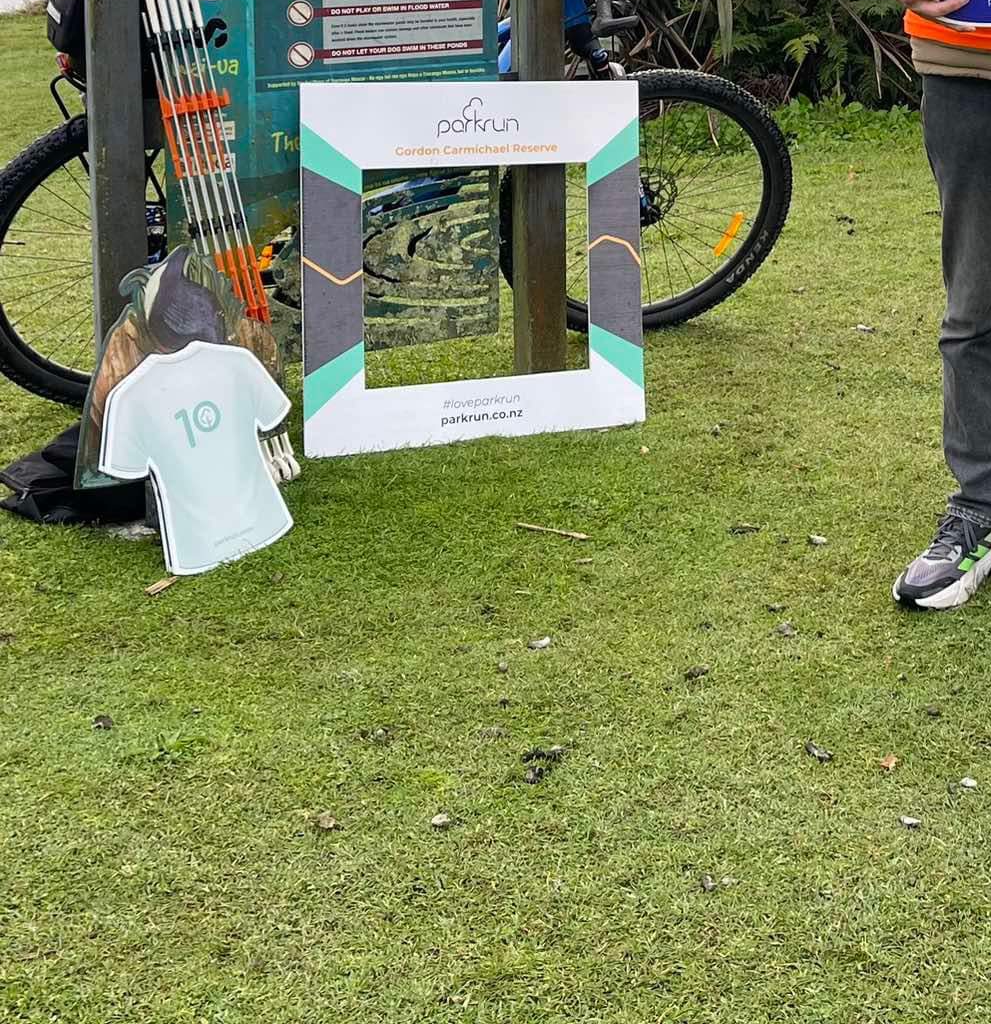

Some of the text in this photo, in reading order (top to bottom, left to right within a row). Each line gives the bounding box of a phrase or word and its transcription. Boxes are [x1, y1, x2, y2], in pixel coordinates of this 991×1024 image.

[383, 5, 400, 13] SWIM
[408, 3, 428, 11] FLOOD
[429, 2, 450, 10] WATER
[369, 47, 386, 55] YOUR
[402, 45, 419, 53] SWIM
[437, 97, 519, 138] parkrun
[395, 142, 558, 157] Gordon Carmichael Reserve
[726, 229, 769, 283] KENDA
[443, 394, 520, 409] #loveparkrun
[174, 400, 221, 448] 10
[441, 409, 523, 427] parkrun.co.nz
